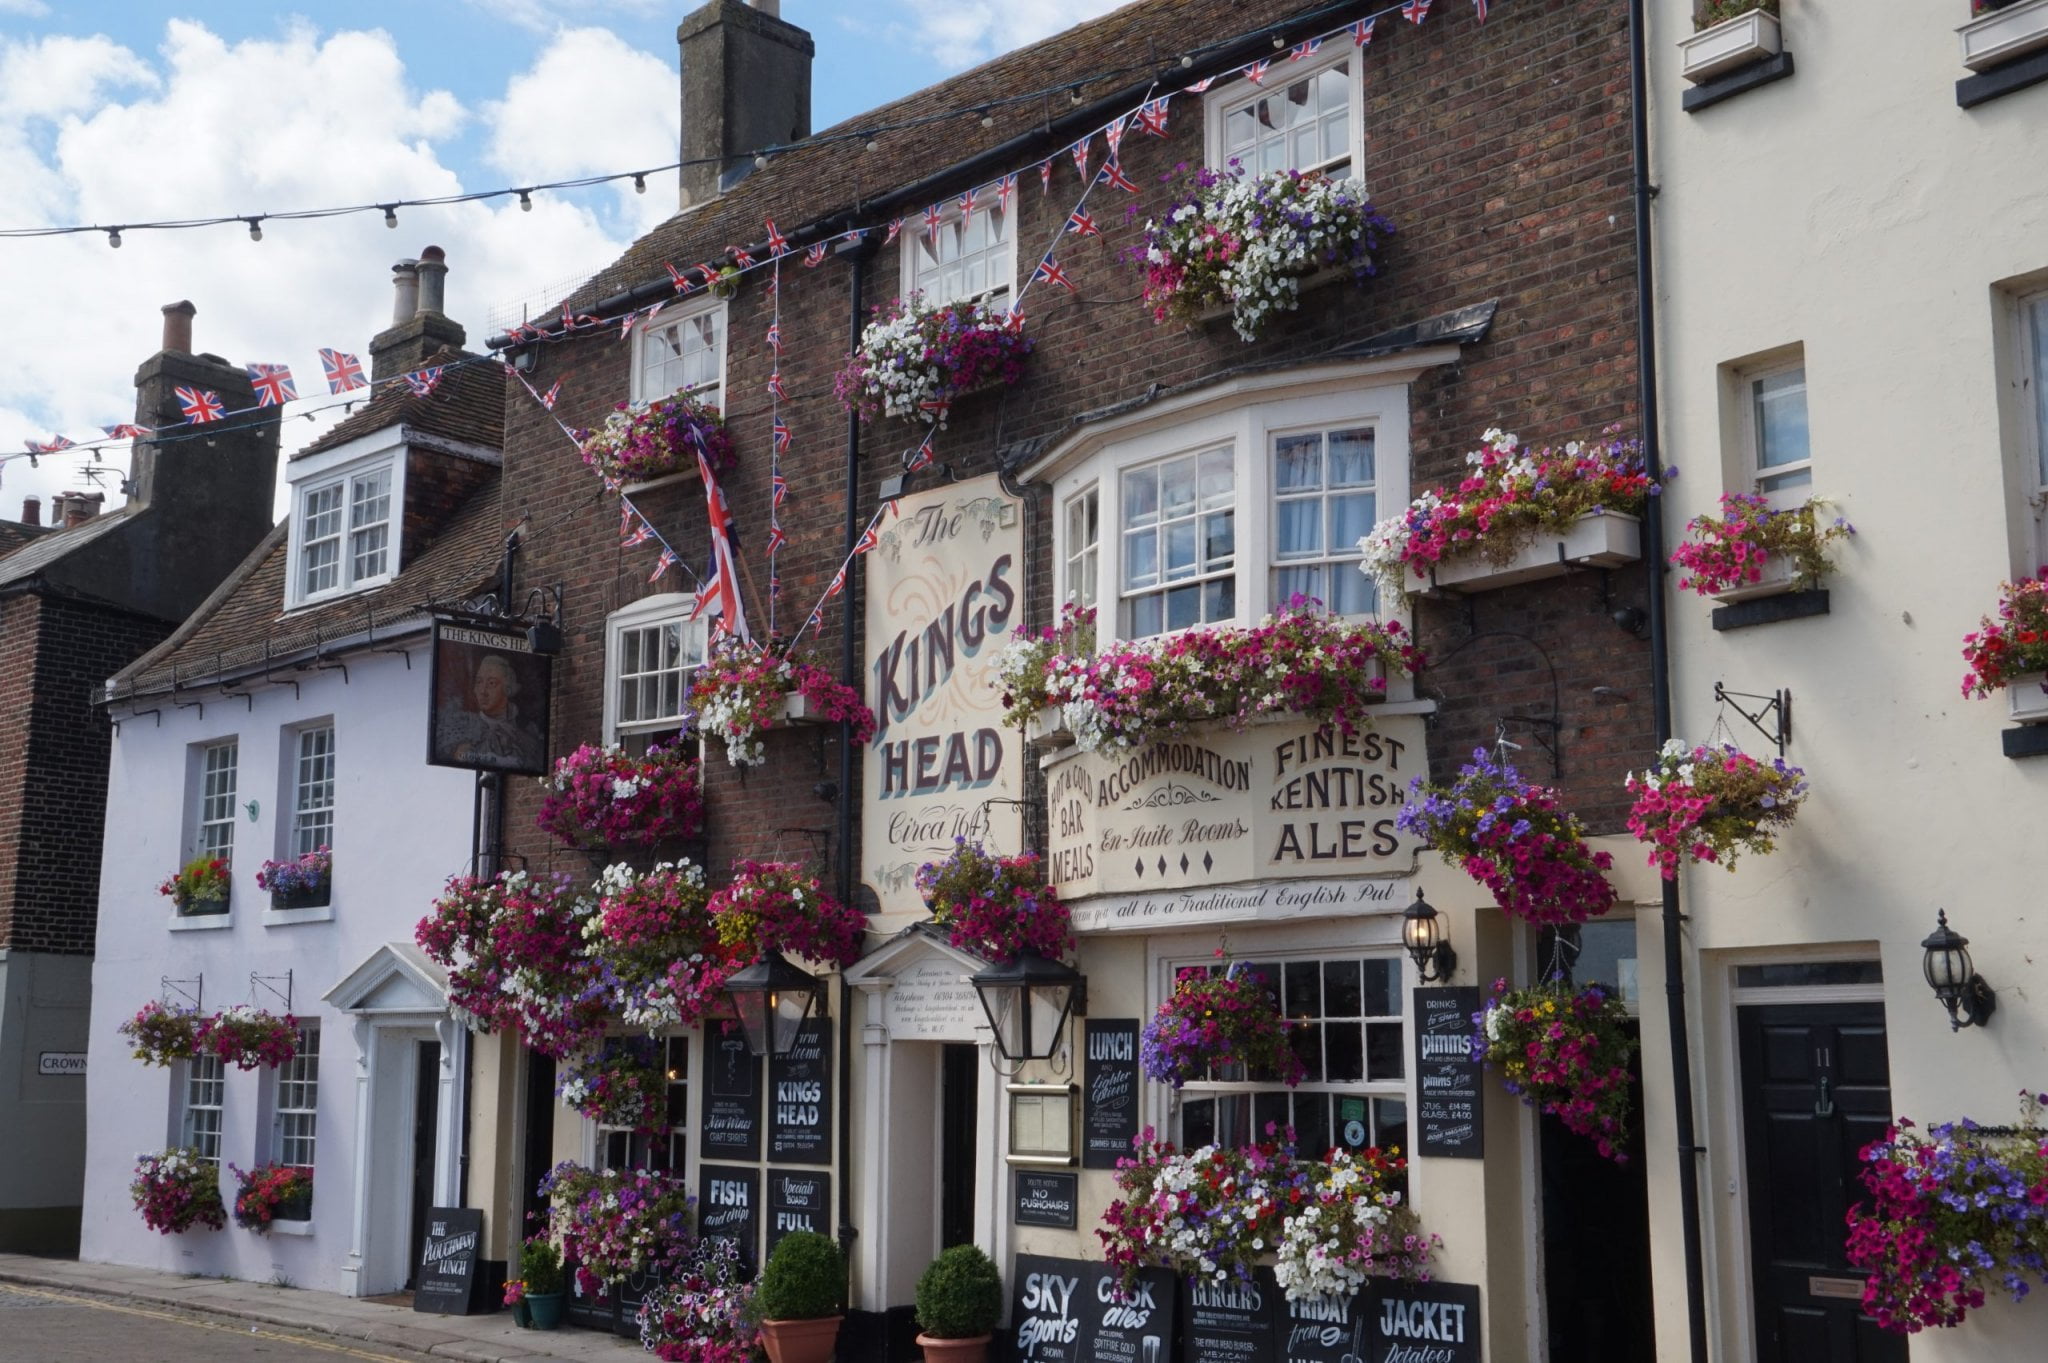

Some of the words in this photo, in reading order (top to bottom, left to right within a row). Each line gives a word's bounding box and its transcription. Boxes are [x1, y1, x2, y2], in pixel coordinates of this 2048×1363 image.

[914, 502, 963, 548] The
[444, 627, 467, 642] THE
[510, 638, 532, 653] HE
[873, 554, 1014, 750] KINGS
[879, 728, 1003, 800] HEAD
[1275, 728, 1405, 778] FINEST
[1073, 764, 1093, 804] COLD
[1098, 743, 1250, 807] ACCOMMODATION
[1271, 767, 1405, 812] KENTISH
[888, 810, 946, 845] Circa
[1060, 799, 1084, 838] BAR
[1178, 818, 1249, 847] Rooms
[1272, 819, 1399, 863] ALES
[1052, 843, 1094, 885] MEALS
[1117, 900, 1138, 918] all
[1143, 900, 1157, 916] to
[1164, 902, 1175, 914] a
[1179, 889, 1268, 914] Traditional
[1275, 885, 1348, 912] English
[1353, 883, 1395, 902] Pub
[1426, 1000, 1457, 1009] DRINKS
[1089, 1032, 1133, 1061] LUNCH
[1421, 1030, 1472, 1060] pimms
[42, 1058, 87, 1069] CROWN
[1423, 1074, 1452, 1090] pimms
[777, 1105, 819, 1126] HEAD
[710, 1180, 748, 1207] FISH
[782, 1177, 814, 1197] Specials
[786, 1194, 808, 1206] BOARD
[1032, 1189, 1048, 1199] NO
[705, 1210, 726, 1226] and
[1021, 1197, 1069, 1211] PUSHCHAIRS
[432, 1221, 447, 1236] THE
[777, 1212, 814, 1232] FULL
[438, 1259, 467, 1276] LUNCH
[1022, 1273, 1078, 1323] SKY
[1192, 1280, 1262, 1311] BURGERS
[1102, 1306, 1150, 1329] ales
[1380, 1298, 1465, 1343] JACKET
[1018, 1315, 1079, 1357] Sports
[1094, 1338, 1119, 1352] SPITFIRE
[1120, 1342, 1136, 1354] GOLD
[1287, 1324, 1320, 1353] from
[1384, 1342, 1456, 1363] Potatoes
